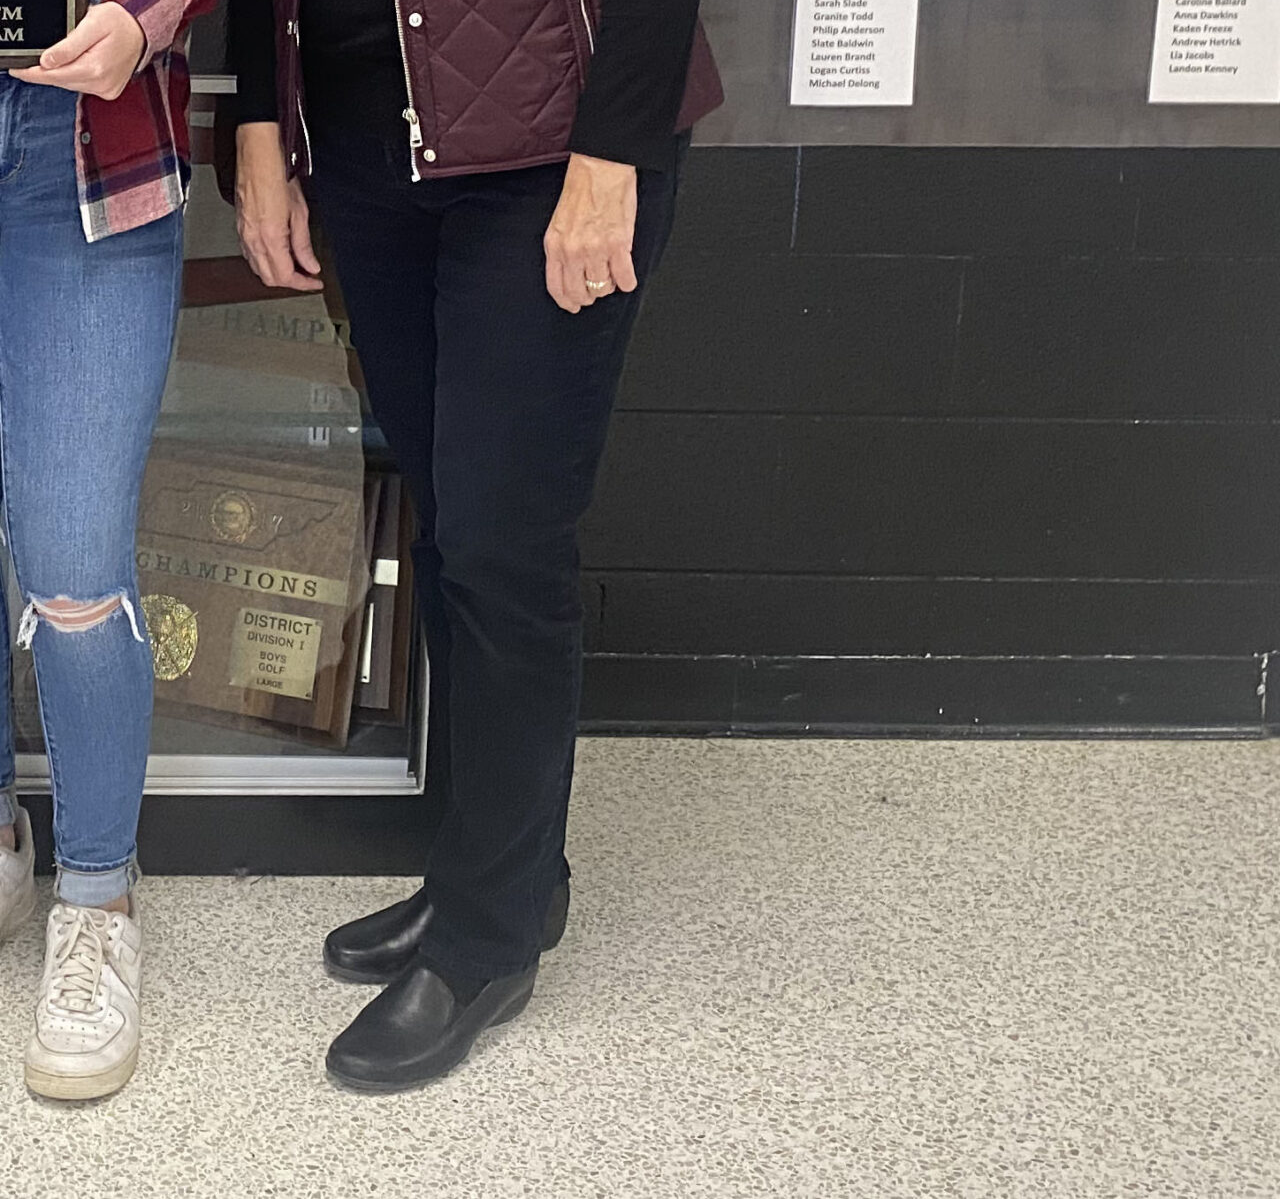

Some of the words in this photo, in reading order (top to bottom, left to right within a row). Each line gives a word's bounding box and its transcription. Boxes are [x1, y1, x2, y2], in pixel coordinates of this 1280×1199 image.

[814, 0, 840, 8] Sarah
[814, 12, 848, 21] Granite
[851, 12, 873, 21] Todd
[1174, 11, 1197, 19] Anna
[841, 26, 884, 34] Anderson
[1172, 37, 1207, 46] Andrew
[811, 53, 842, 61] Lauren
[845, 52, 875, 61] Brandt
[810, 66, 837, 76] Logan
[1169, 64, 1202, 73] Landon
[809, 79, 846, 88] Michael
[136, 552, 318, 597] CHAMPIONS
[244, 612, 313, 636] DISTRICT
[247, 632, 294, 649] DIVISION
[259, 651, 287, 664] BOYS
[259, 663, 286, 675] GOLF
